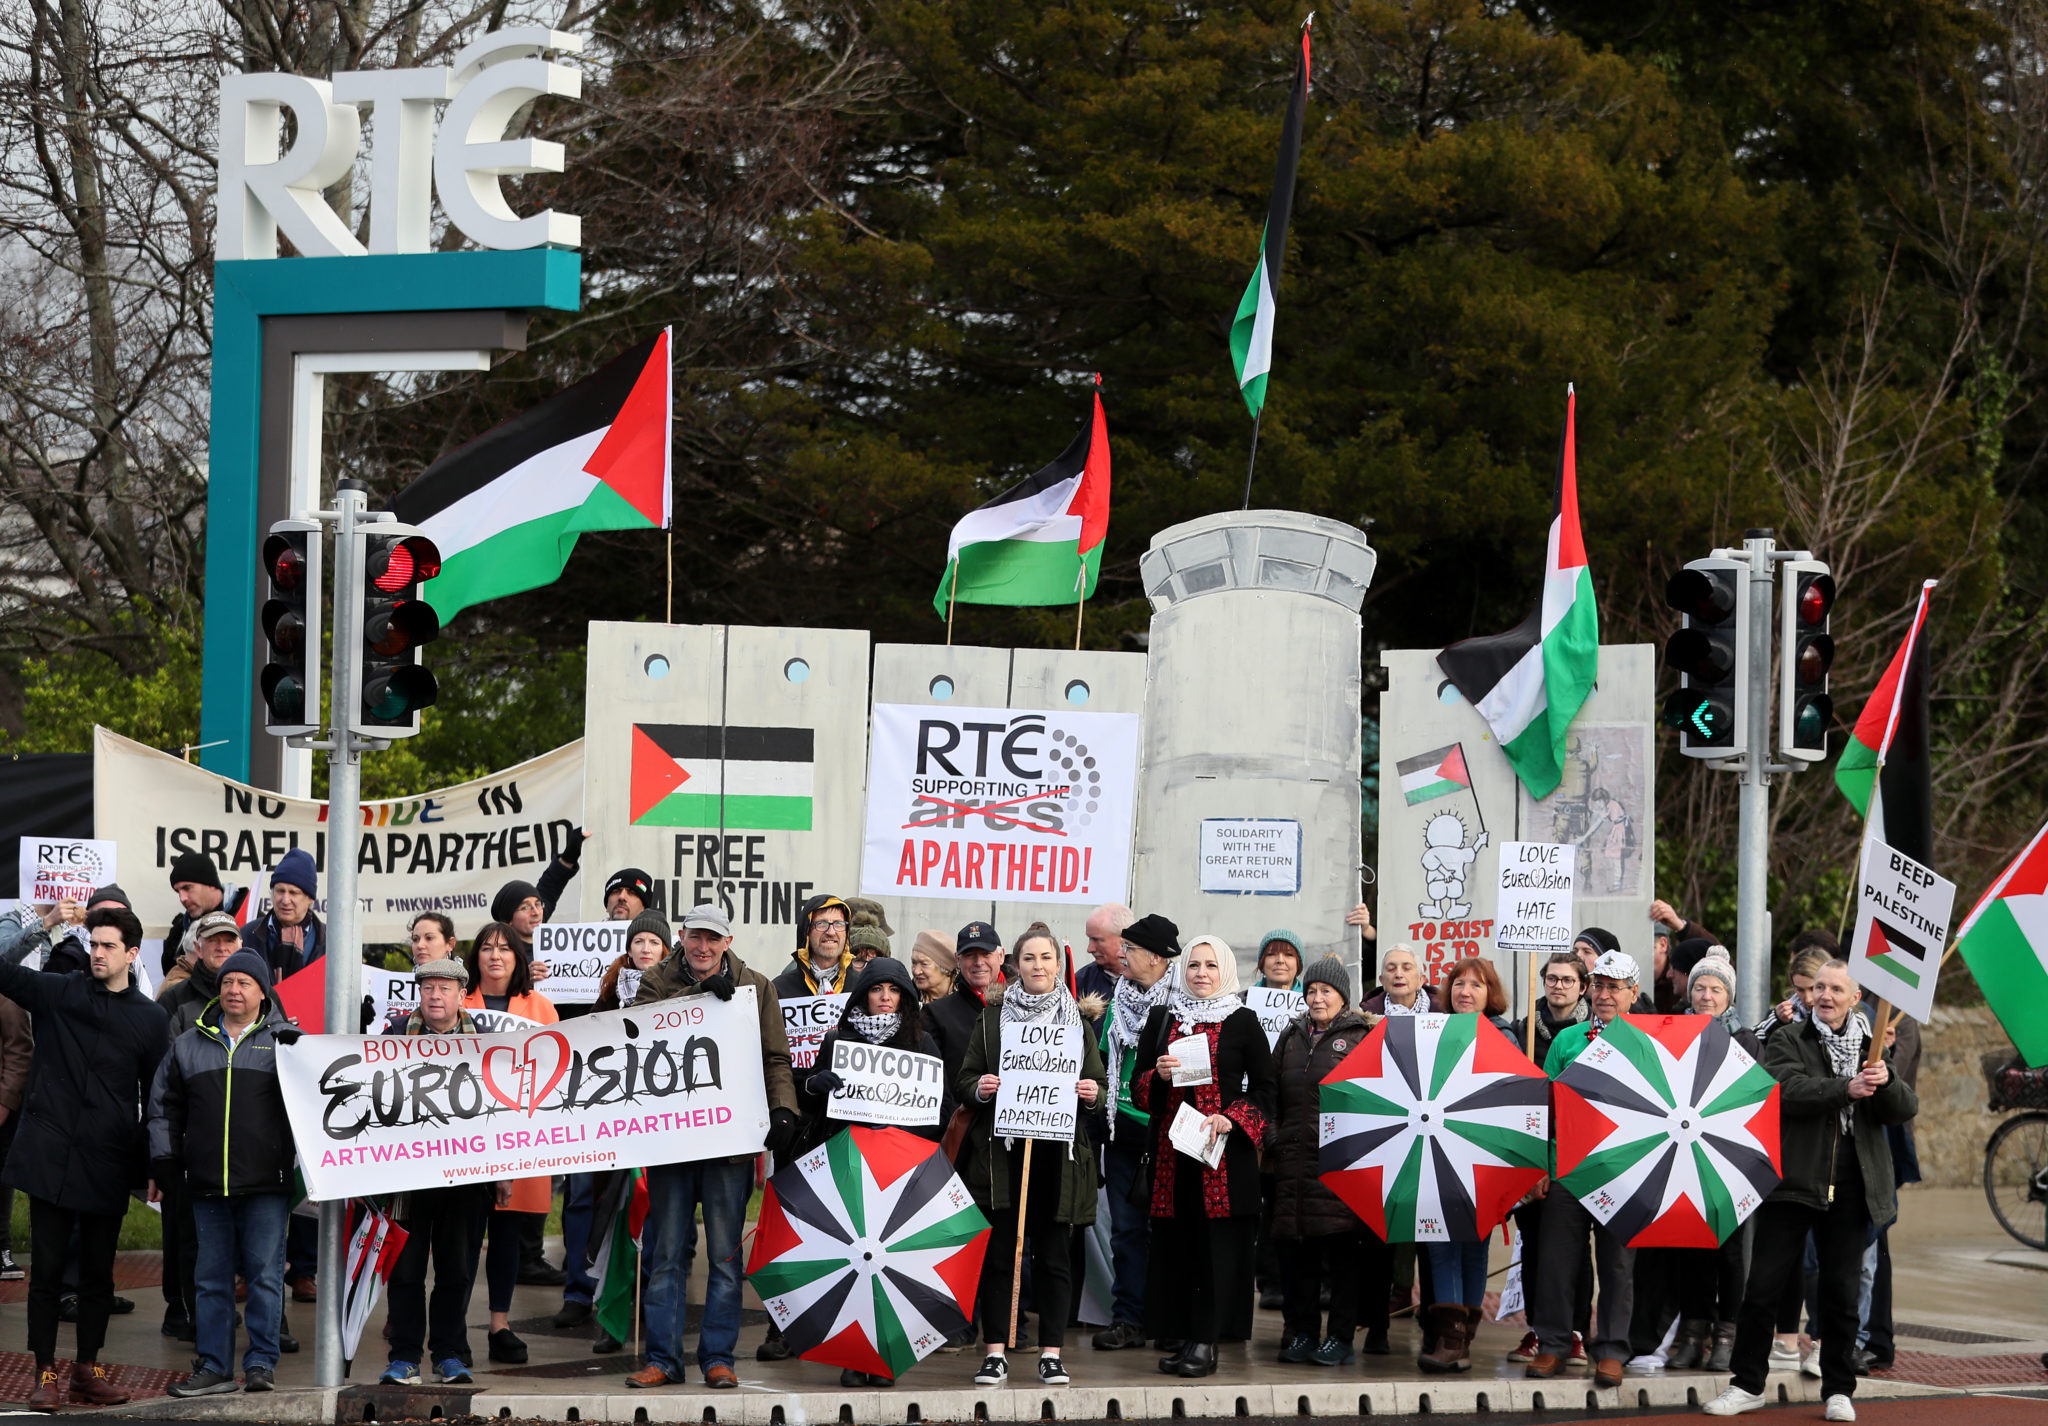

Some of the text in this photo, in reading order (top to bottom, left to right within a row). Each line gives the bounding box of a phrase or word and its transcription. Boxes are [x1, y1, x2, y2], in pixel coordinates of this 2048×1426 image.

[915, 714, 1046, 780] RTÉ
[911, 778, 1070, 799] SUPPORTING THE
[223, 783, 287, 819] NO
[477, 781, 523, 816] IN
[908, 796, 1065, 833] arts
[1216, 828, 1283, 838] SOLIDARITY
[38, 842, 83, 865] RTÉ
[358, 819, 574, 874] APARTHEID
[674, 834, 765, 879] FREE
[1222, 842, 1276, 852] WITH THE
[1519, 845, 1560, 864] LOVE
[896, 838, 1092, 894] APARTHEID!
[1205, 855, 1292, 866] GREAT RETURN
[1889, 853, 1935, 889] BEEP
[1228, 869, 1269, 879] MARCH
[386, 893, 488, 912] PINKWASHING
[650, 880, 814, 925] ALESTINE
[1896, 881, 1920, 904] For
[1516, 902, 1556, 920] HATE
[1864, 884, 1944, 942] PALESTINE
[540, 927, 626, 952] BOYCOT
[1408, 919, 1494, 941] TO EXIST
[1500, 924, 1570, 941] APARTHEID
[1425, 940, 1480, 962] IS TO
[387, 979, 418, 1001] RT
[1265, 990, 1305, 1012] LOVE
[653, 1006, 704, 1030] 2019
[787, 1034, 823, 1047] art
[1021, 1025, 1065, 1046] LOVE
[363, 1037, 482, 1064] BOYCOTT
[833, 1044, 942, 1083] BOYCOTT
[1017, 1085, 1060, 1105] HATE
[829, 1108, 873, 1118] ARTWASHING
[997, 1108, 1074, 1128] APARTHEID
[320, 1106, 732, 1168] ARTWASHING ISRAELI APARTHEID
[443, 1151, 617, 1178] www.ipsc.ie/eurovision
